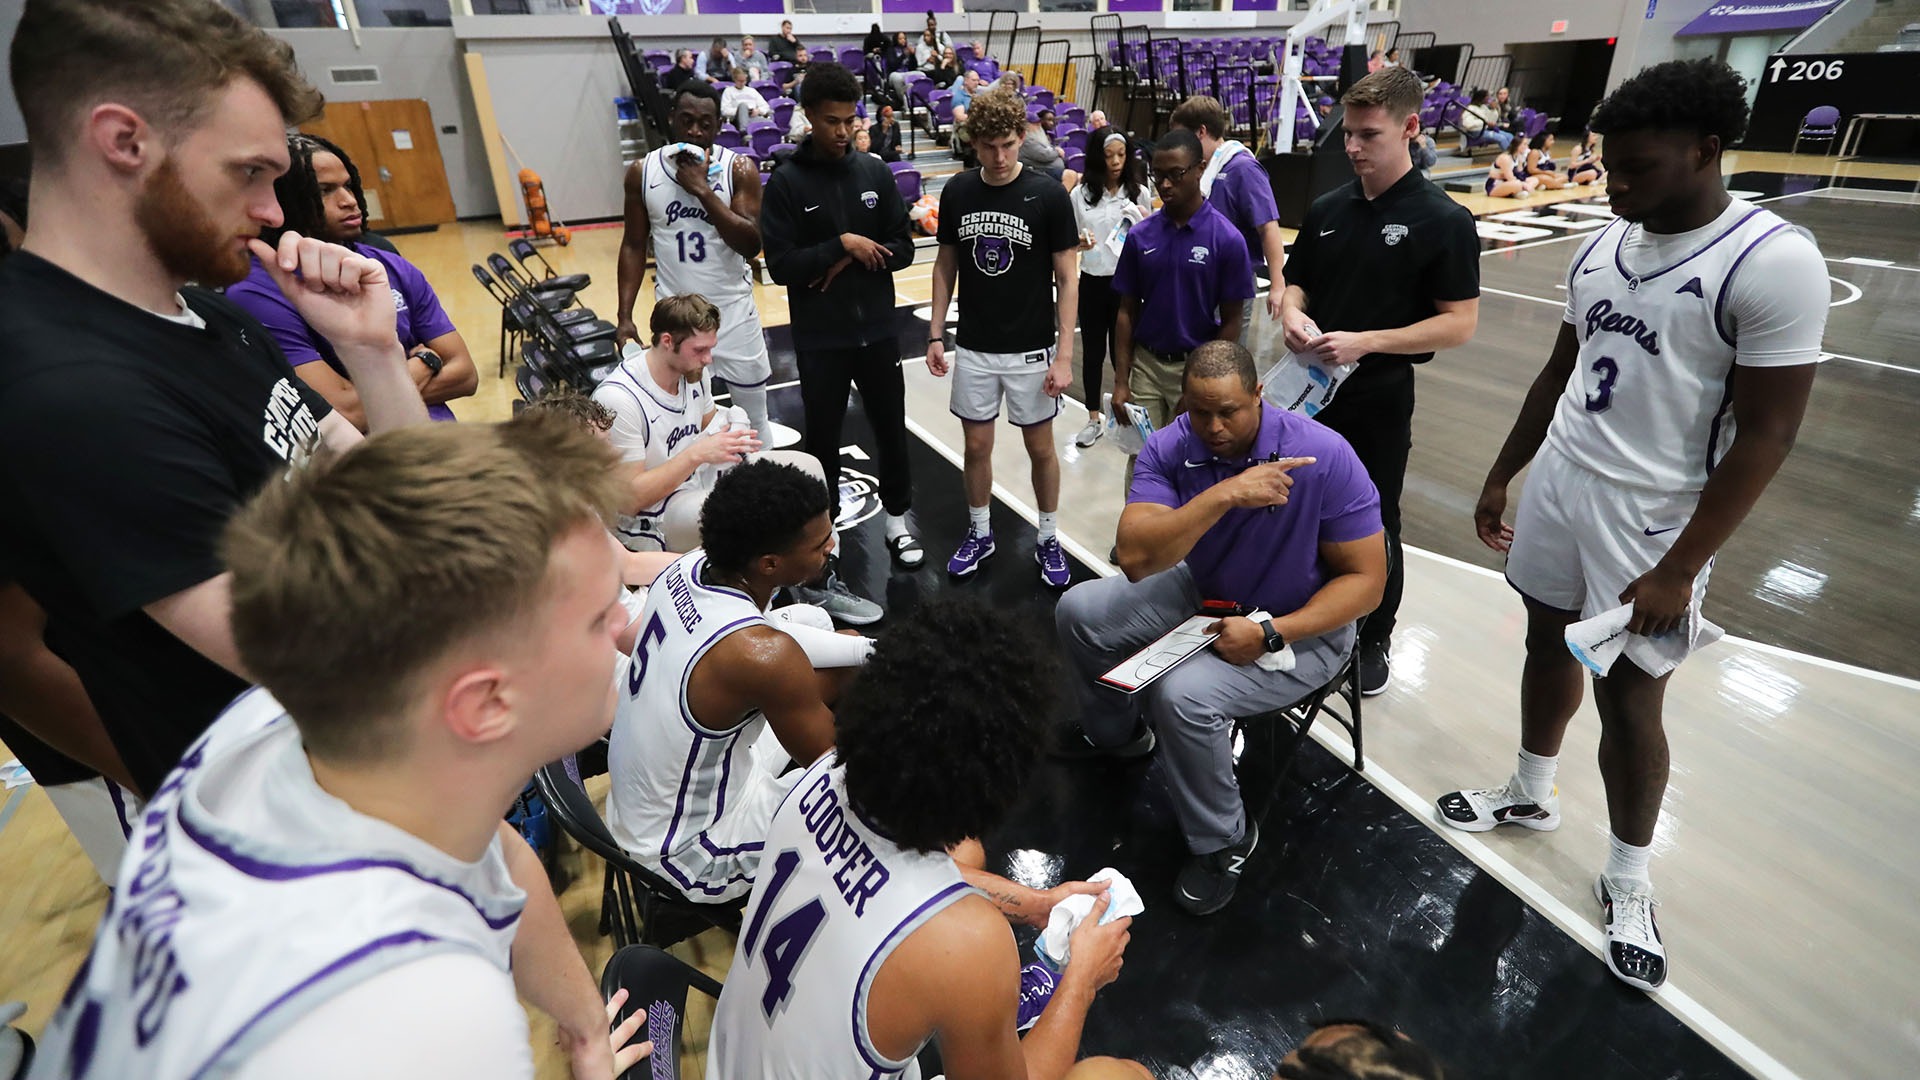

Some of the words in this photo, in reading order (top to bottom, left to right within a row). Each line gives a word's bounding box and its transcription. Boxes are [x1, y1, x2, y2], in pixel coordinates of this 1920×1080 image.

[1787, 60, 1845, 81] 206
[665, 200, 709, 226] Bear
[958, 222, 1033, 244] ARKANSAS
[961, 211, 1029, 242] CENTRAL
[676, 231, 706, 262] 13
[1585, 299, 1660, 356] Bears
[1585, 356, 1619, 415] 3
[628, 609, 668, 701] 5
[799, 773, 890, 919] COOPER
[742, 848, 830, 1029] 14
